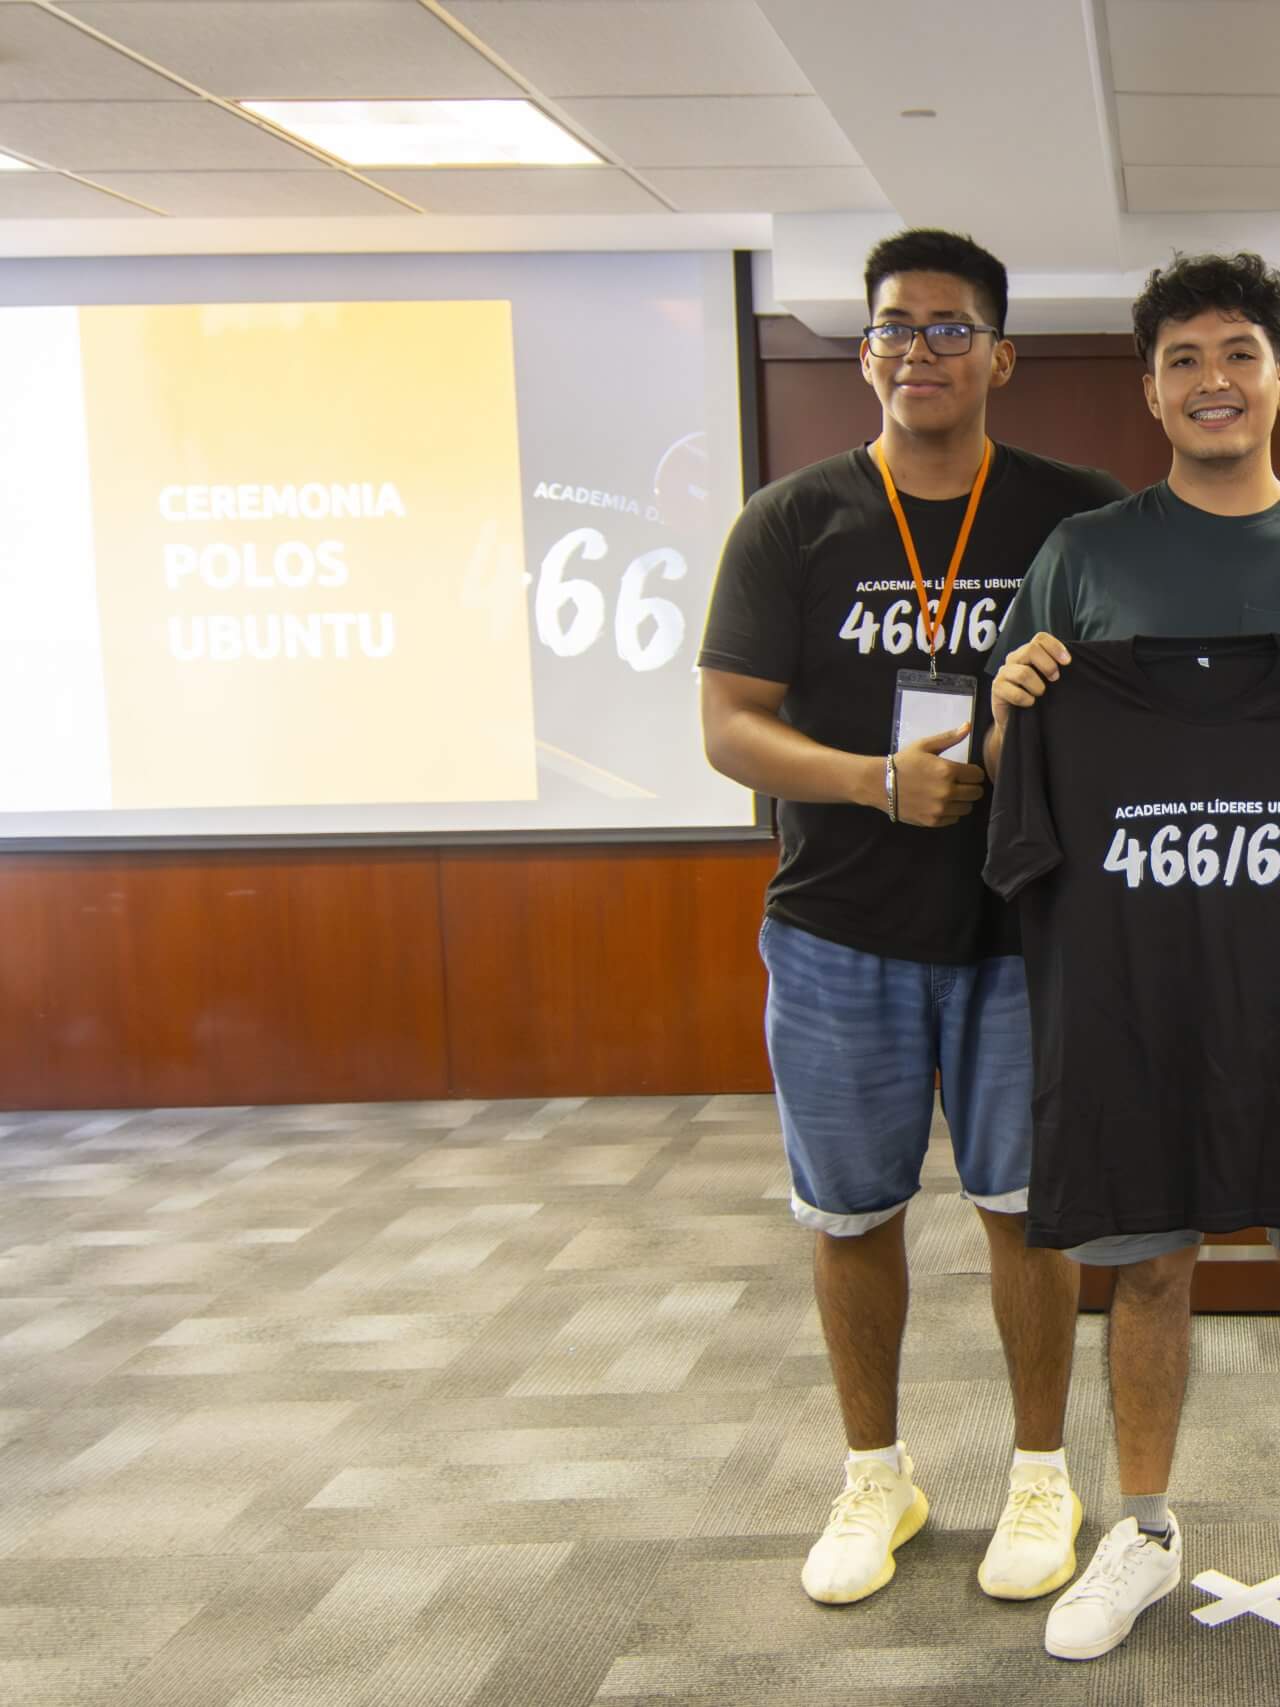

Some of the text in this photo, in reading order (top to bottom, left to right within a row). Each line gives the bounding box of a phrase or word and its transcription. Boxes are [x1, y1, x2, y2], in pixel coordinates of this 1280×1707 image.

[159, 483, 406, 520] CEREMONIA
[533, 481, 640, 516] ACADEMIA
[163, 541, 348, 590] POLOS
[856, 580, 916, 592] ACADEMIA
[935, 576, 981, 590] LÍERES
[985, 578, 1025, 589] UBUNT
[461, 518, 703, 686] 466
[167, 613, 394, 660] UBUNTU
[1115, 802, 1187, 819] ACADEMIA
[1190, 801, 1204, 812] DE
[1207, 798, 1263, 814] LÍDERES
